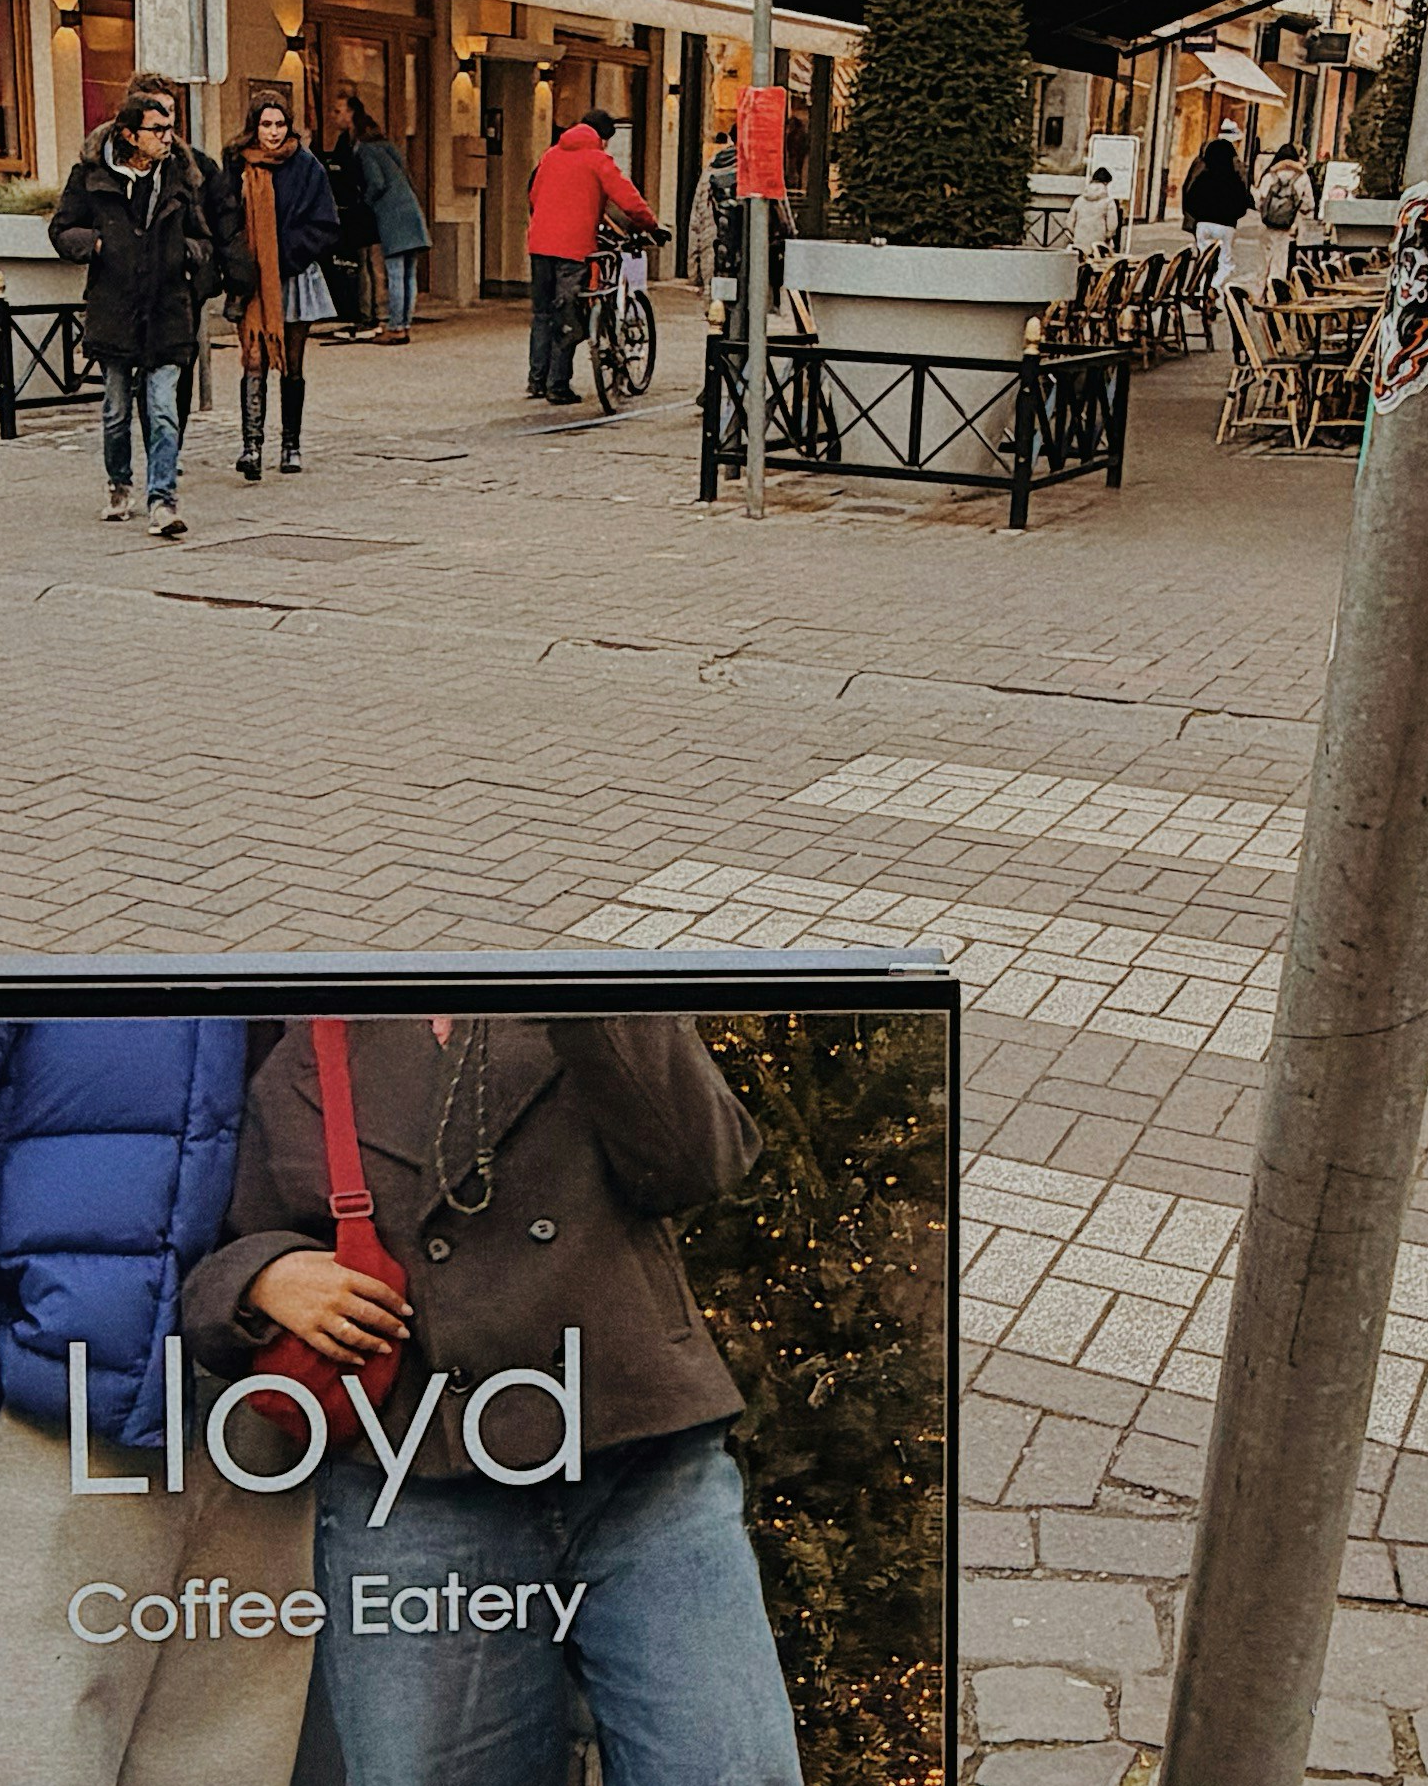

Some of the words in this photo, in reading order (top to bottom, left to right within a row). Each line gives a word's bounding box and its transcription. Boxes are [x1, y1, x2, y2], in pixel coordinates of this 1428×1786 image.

[68, 1326, 582, 1528] Lloyd
[67, 1576, 327, 1644] Coffee
[351, 1571, 588, 1643] Eatery
